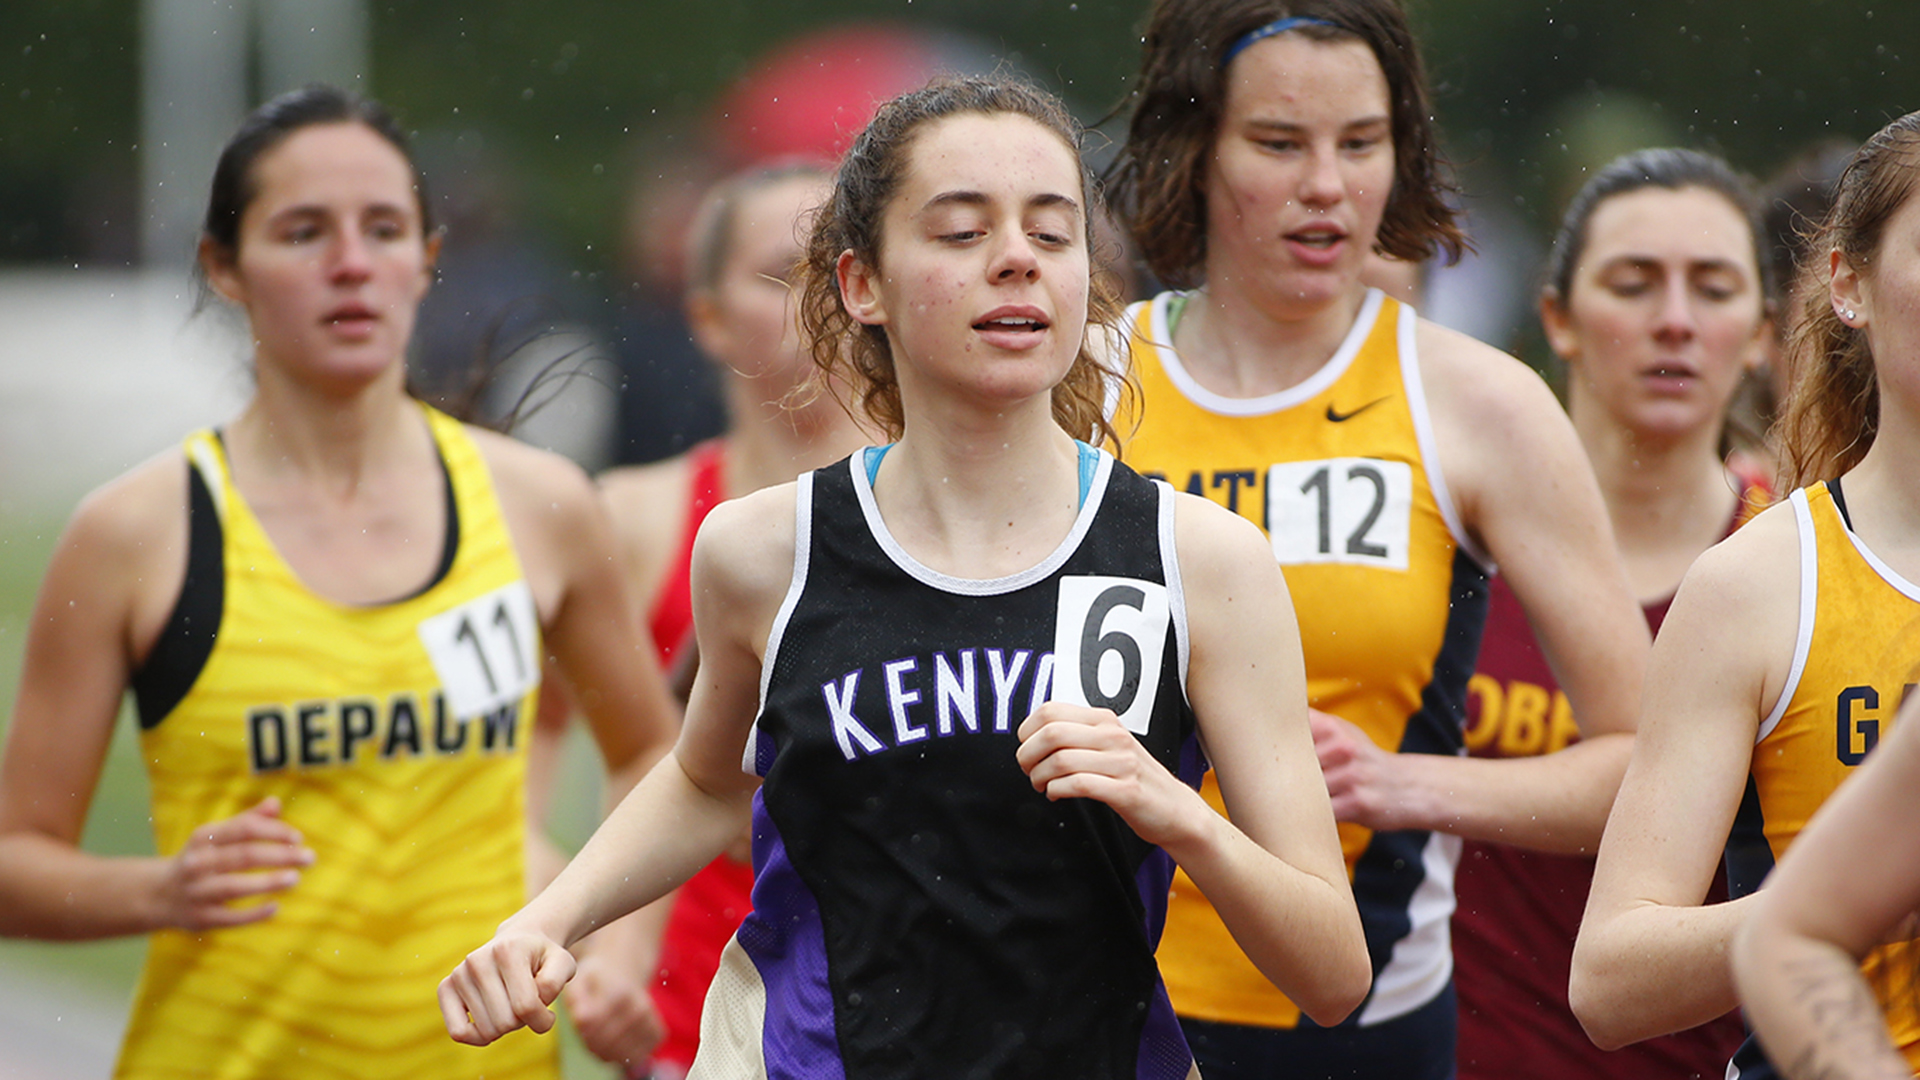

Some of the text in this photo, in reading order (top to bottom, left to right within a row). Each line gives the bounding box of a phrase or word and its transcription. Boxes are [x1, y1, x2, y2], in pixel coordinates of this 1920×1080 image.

[1300, 464, 1388, 558] 12
[455, 598, 526, 696] 11
[1079, 584, 1146, 717] 6
